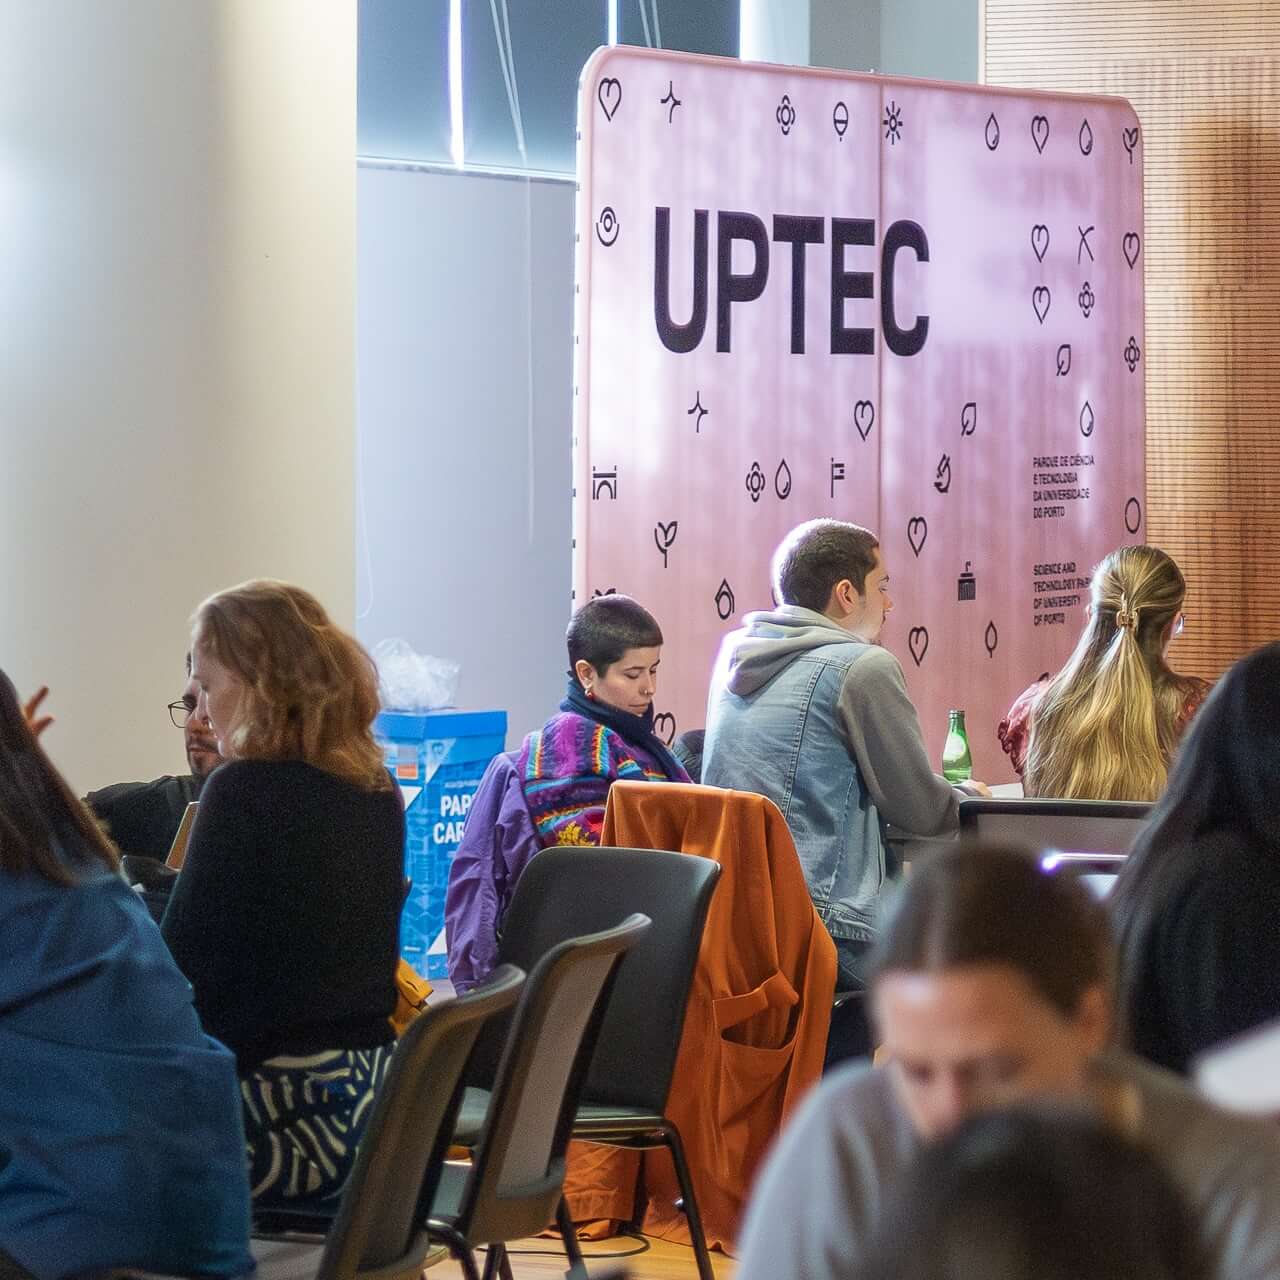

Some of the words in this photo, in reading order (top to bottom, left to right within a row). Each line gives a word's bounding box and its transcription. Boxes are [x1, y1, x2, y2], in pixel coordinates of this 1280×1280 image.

[654, 206, 930, 357] UPTEC
[1033, 456, 1058, 468] PARQUE
[1060, 455, 1069, 467] DE
[1070, 453, 1095, 466] CIÊNCIA
[1033, 473, 1038, 485] E
[1039, 472, 1078, 485] TECNOLOGIA
[1033, 490, 1042, 501] DA
[1043, 488, 1090, 501] UNIVERSIDADE
[1033, 507, 1042, 518] DO
[1044, 506, 1065, 518] PORTO
[1033, 563, 1061, 576] SCIENCE
[1062, 562, 1076, 573] AND
[1033, 579, 1076, 592] TECHNOLOGY
[1077, 577, 1091, 589] PAR
[1033, 598, 1042, 609] OF
[1043, 595, 1081, 608] UNIVERSITY
[1033, 615, 1042, 626] OF
[1043, 613, 1065, 625] PORTO
[440, 794, 472, 817] PAP
[433, 822, 465, 845] CAR
